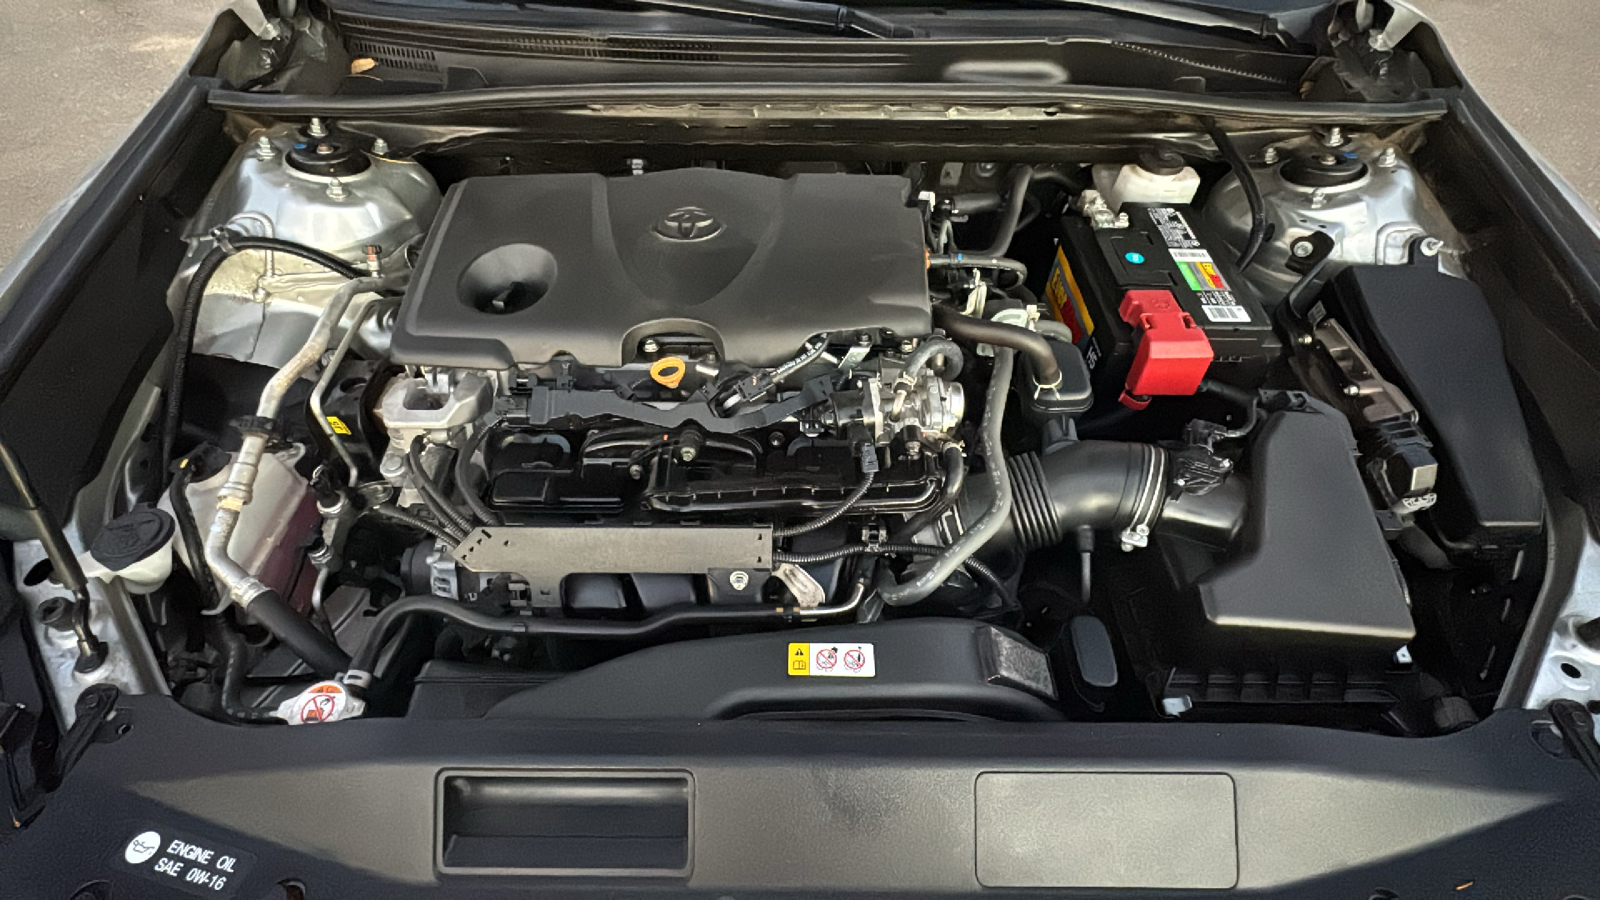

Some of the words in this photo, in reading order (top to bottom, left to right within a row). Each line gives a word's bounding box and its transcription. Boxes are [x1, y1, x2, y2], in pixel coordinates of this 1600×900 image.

[166, 840, 214, 864] ENGINE
[216, 855, 237, 873] OIL
[154, 857, 184, 877] SAE
[186, 867, 227, 891] 0W-16
